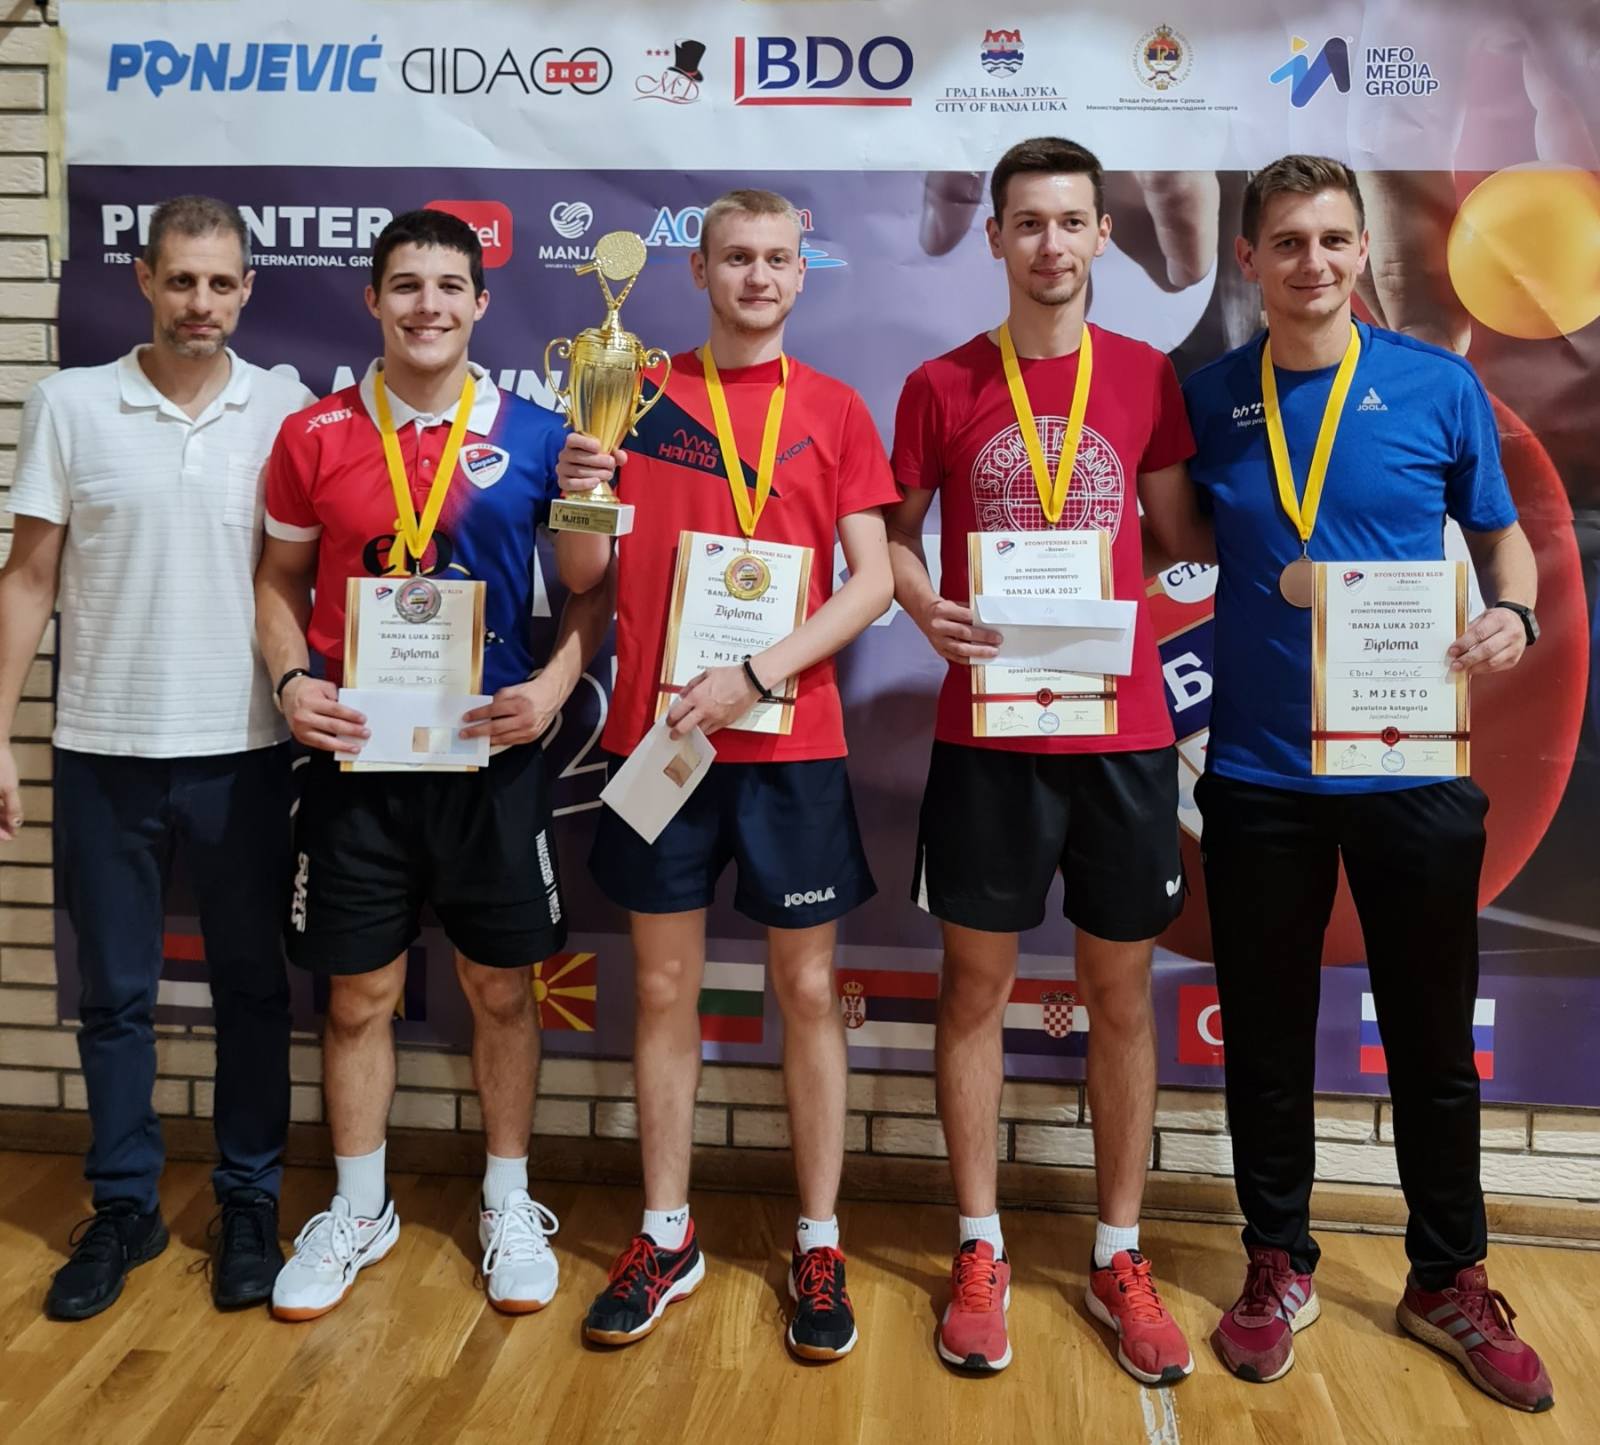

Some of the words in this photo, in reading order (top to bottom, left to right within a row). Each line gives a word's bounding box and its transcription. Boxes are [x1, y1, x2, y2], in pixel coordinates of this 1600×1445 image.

[1366, 47, 1414, 63] INFO
[107, 35, 383, 98] PONJEVIĆ
[757, 36, 914, 91] BDO
[548, 67, 598, 80] SHOP
[1366, 64, 1431, 79] MEDIA
[945, 87, 977, 98] ГРАД
[980, 87, 1019, 98] БАЊА
[1020, 86, 1058, 97] ЛУКА
[1365, 80, 1439, 96] GROUP
[935, 102, 967, 113] CITY
[969, 102, 988, 113] OF
[990, 102, 1029, 113] BANJA
[1031, 101, 1067, 112] LUKA
[250, 254, 346, 267] TERNATIONAL
[776, 436, 815, 464] XIOM
[979, 434, 1026, 492] STON
[715, 604, 763, 620] Diploma
[1363, 638, 1419, 653] Diploma
[390, 647, 440, 661] Diploma
[714, 652, 747, 663] MJES
[1352, 689, 1363, 698] 3.
[1369, 689, 1428, 698] MJESTO
[784, 888, 836, 907] JOOLA
